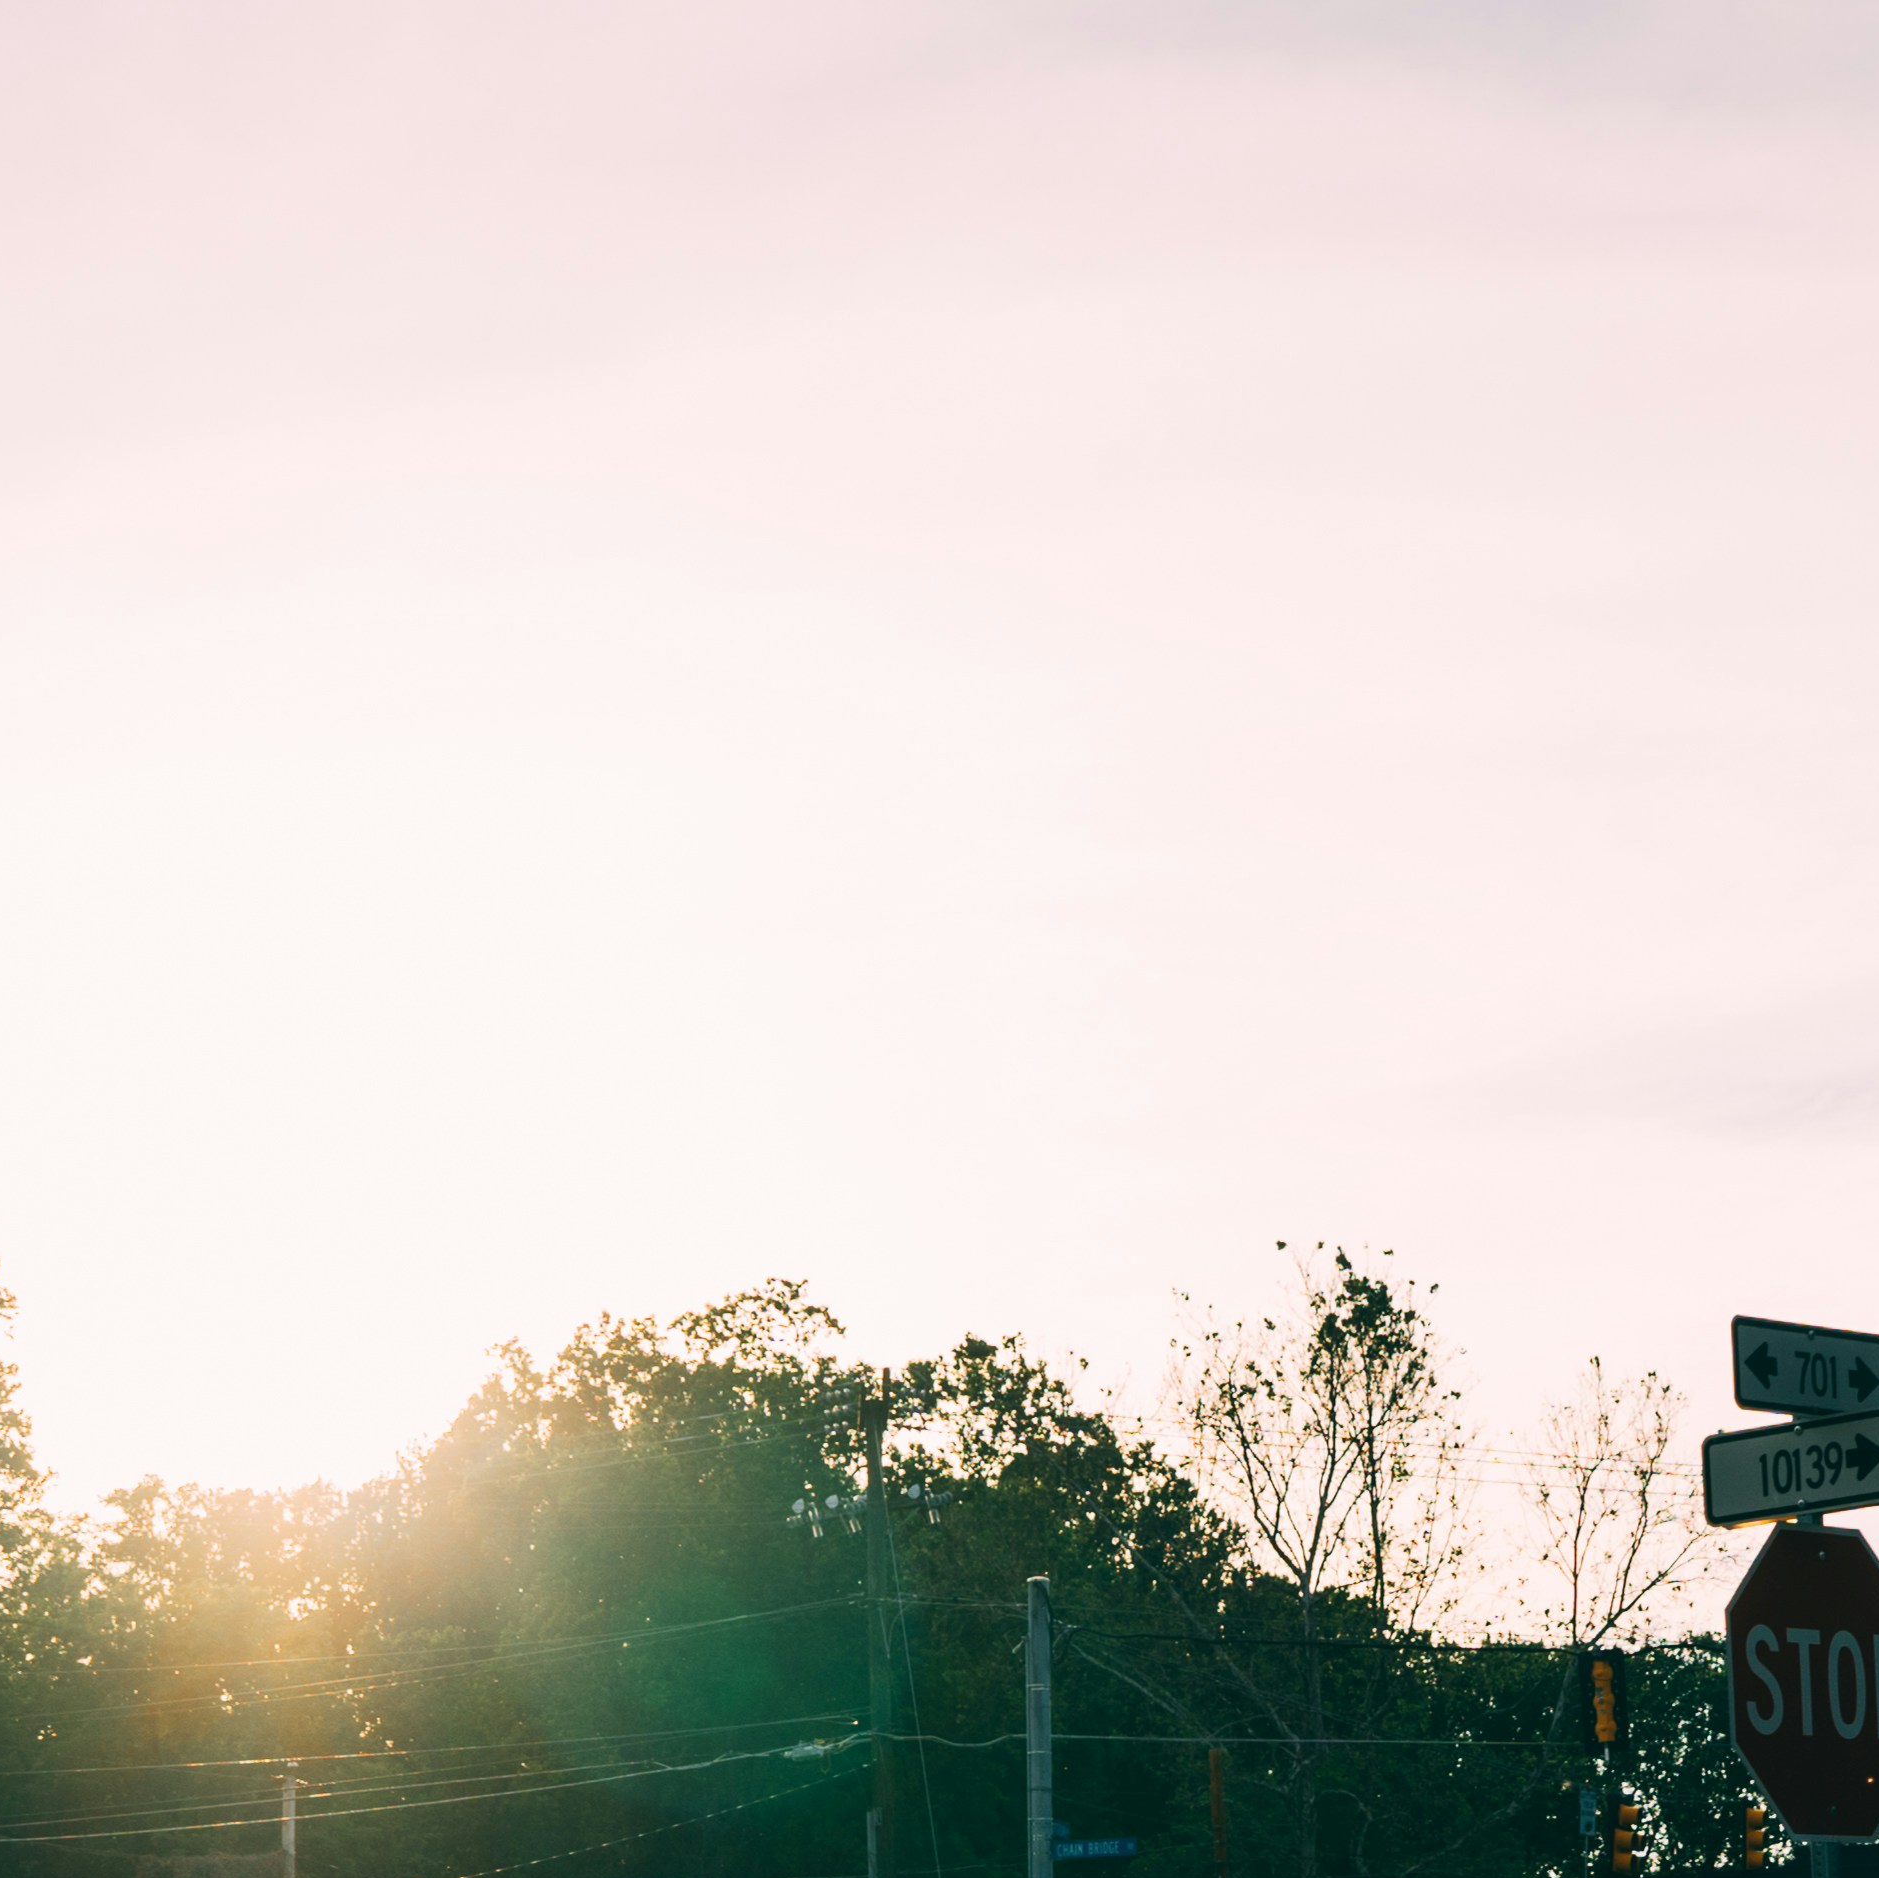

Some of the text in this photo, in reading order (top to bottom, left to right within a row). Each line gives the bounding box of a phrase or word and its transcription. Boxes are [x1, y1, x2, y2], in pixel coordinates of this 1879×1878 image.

[1794, 1350, 1838, 1399] 701
[1759, 1441, 1843, 1498] 10139
[1056, 1842, 1084, 1857] CHAIN
[1088, 1840, 1120, 1856] BRIDGE
